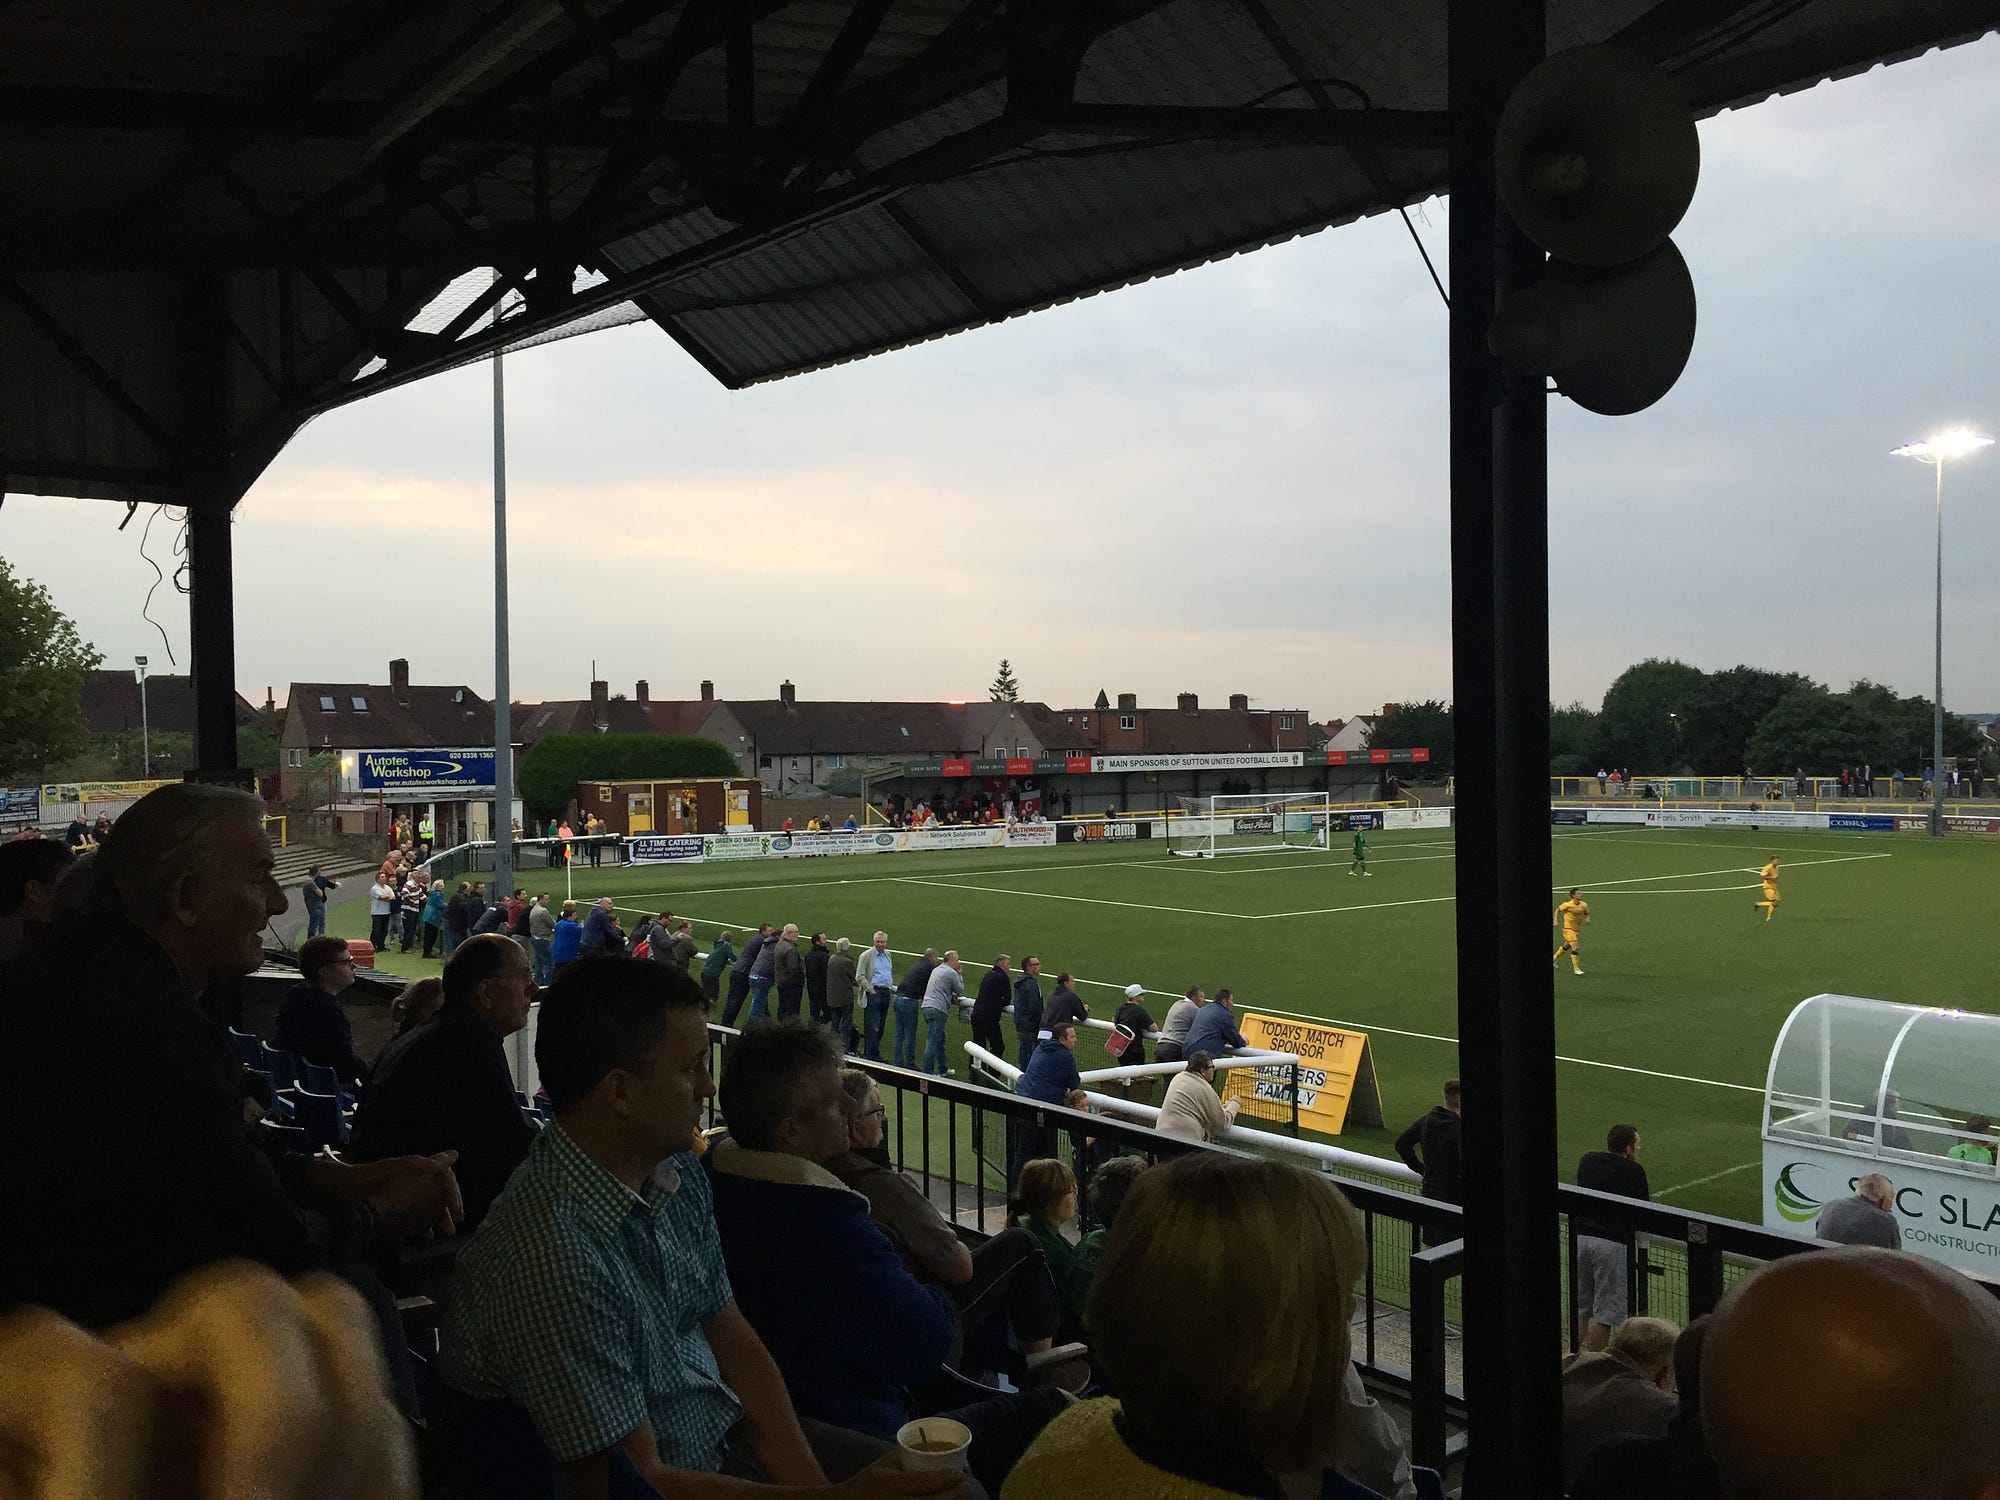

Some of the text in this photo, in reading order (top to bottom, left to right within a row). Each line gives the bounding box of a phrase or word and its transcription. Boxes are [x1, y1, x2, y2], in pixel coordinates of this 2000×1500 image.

[365, 754, 408, 767] Autotec
[1110, 760, 1128, 768] MAIN
[1130, 759, 1169, 768] SPONSORS
[1170, 758, 1180, 766] OF
[1182, 758, 1210, 766] SUTTON
[1236, 756, 1270, 764] FOOTBALL
[1272, 756, 1288, 764] CLUB
[371, 765, 431, 779] Workshop
[1679, 813, 1703, 822] Smith
[1085, 823, 1137, 838] vanarama
[649, 839, 667, 847] TIME
[668, 838, 702, 846] CATERING
[1261, 1020, 1345, 1048] TODAYS MATCH
[1269, 1038, 1325, 1060] SPONSOR
